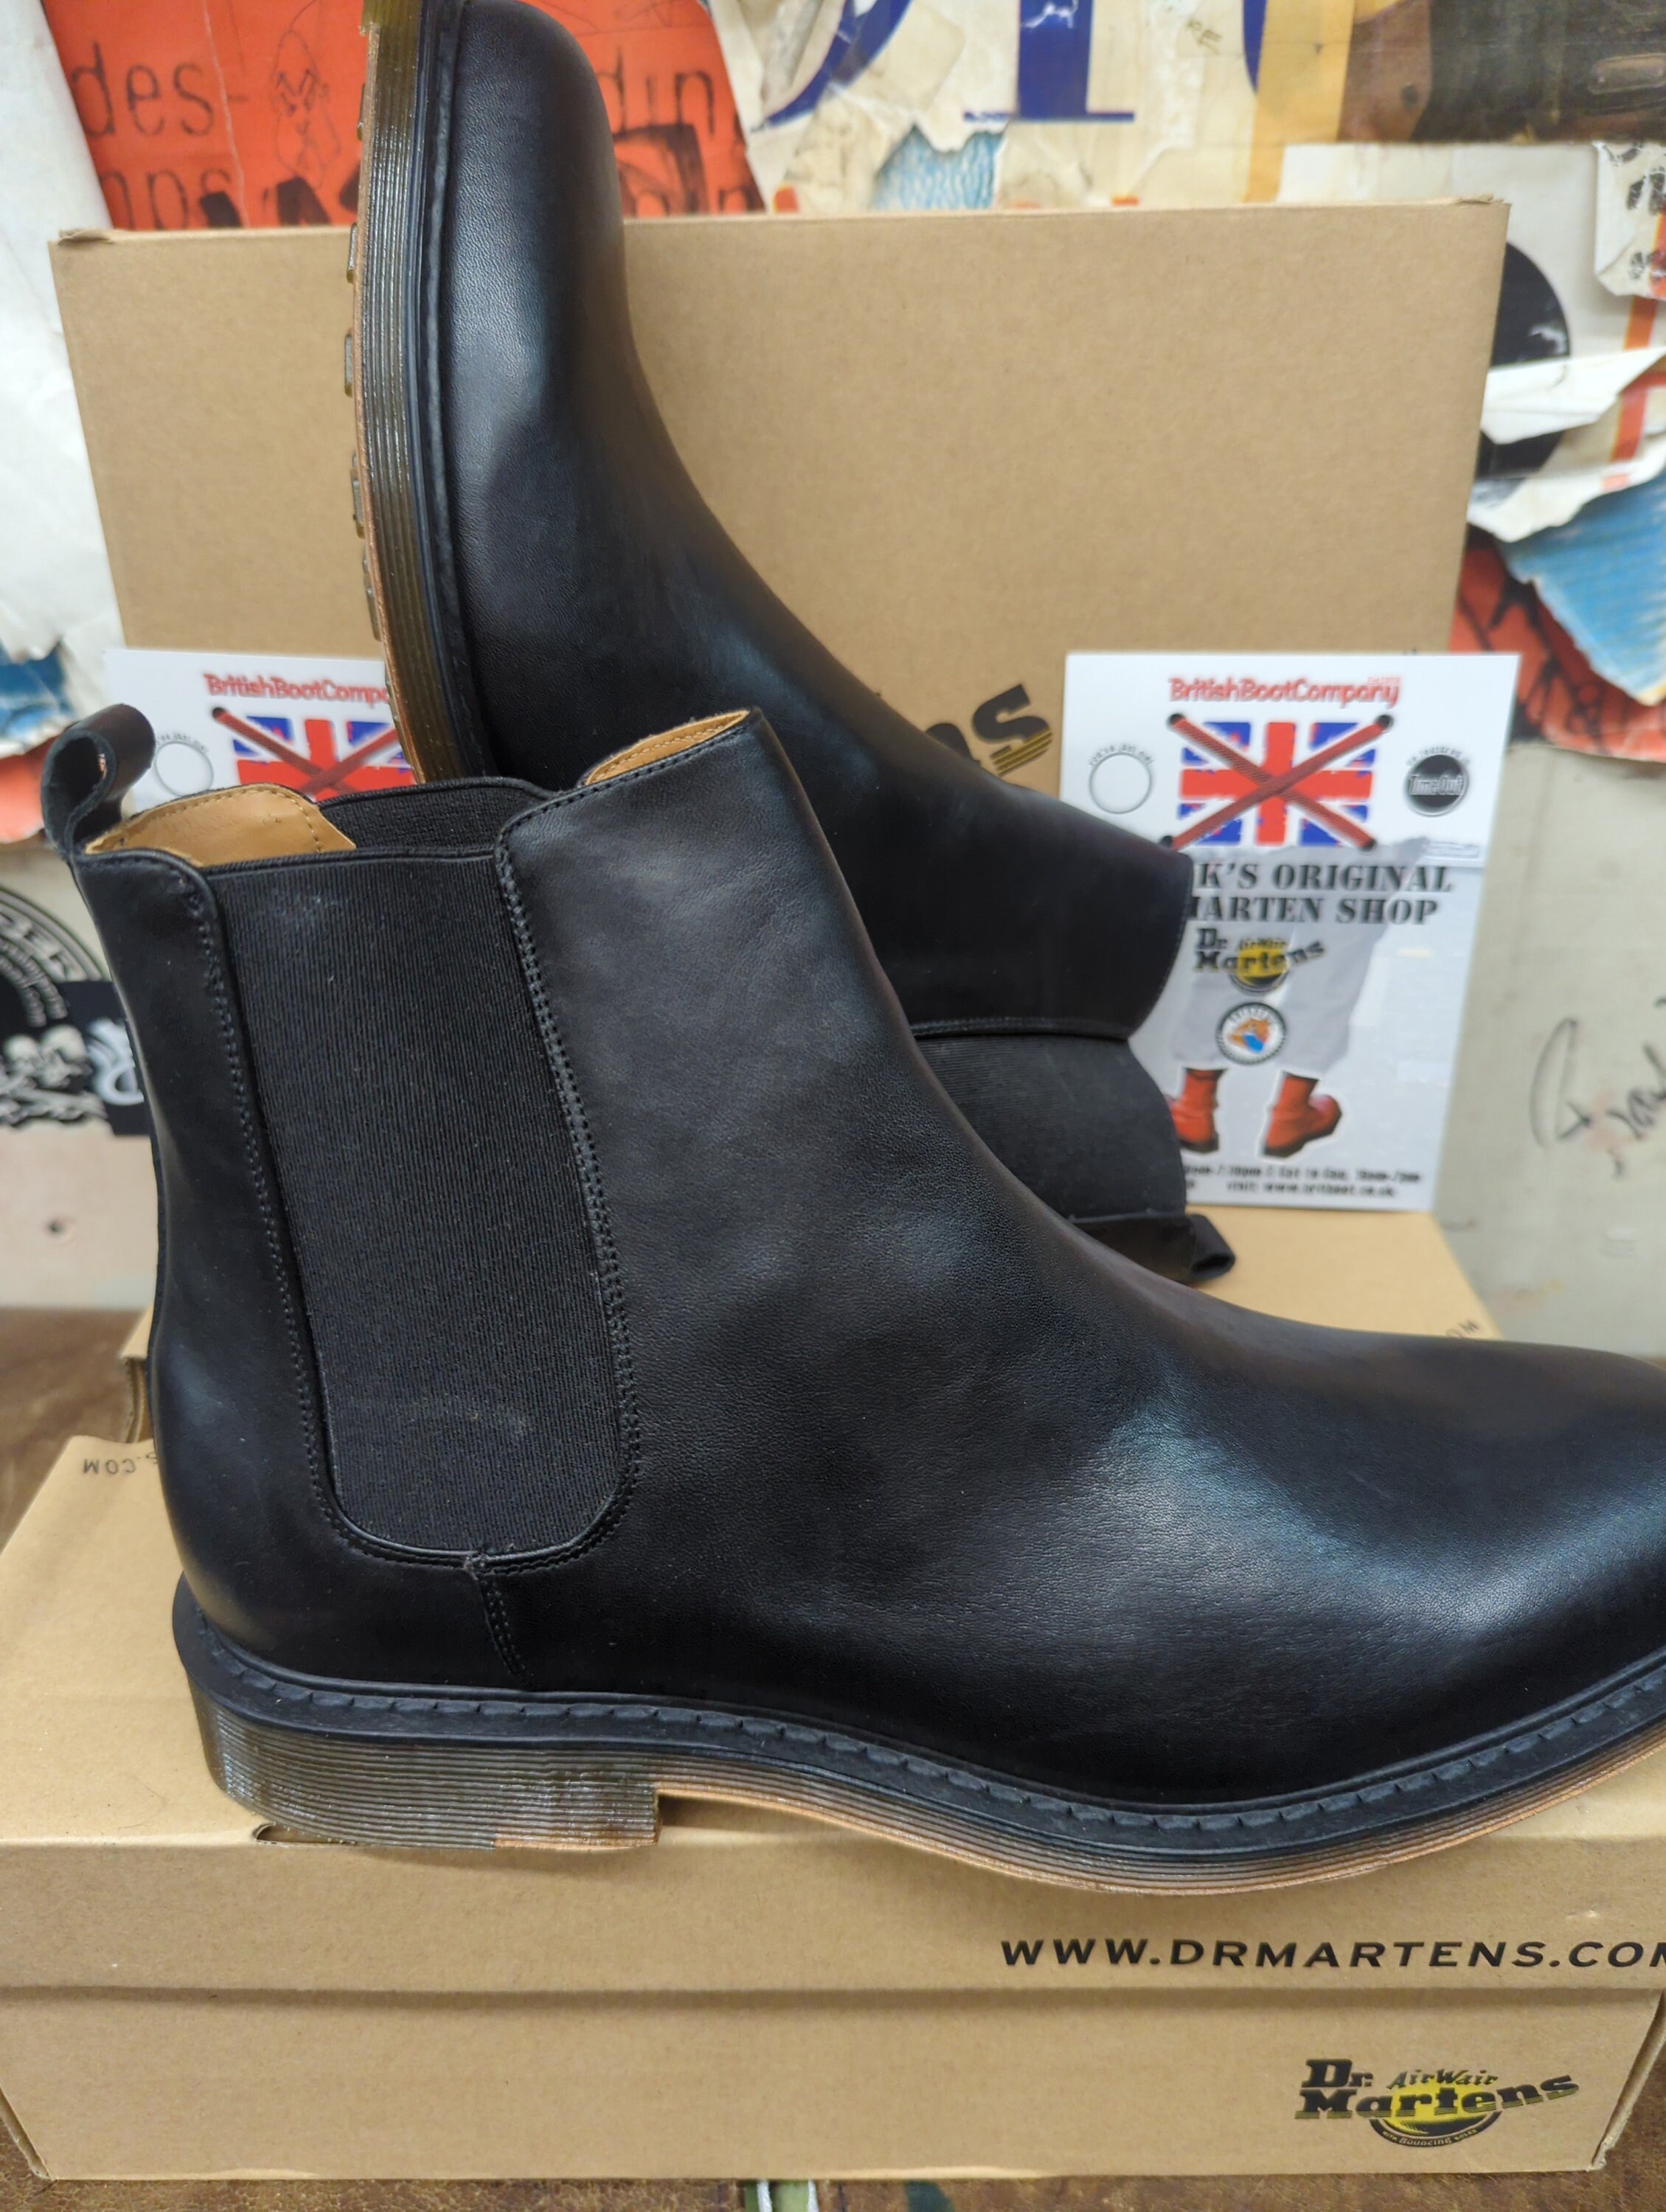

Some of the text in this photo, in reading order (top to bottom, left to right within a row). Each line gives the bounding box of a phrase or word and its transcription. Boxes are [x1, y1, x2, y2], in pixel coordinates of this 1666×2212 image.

[204, 672, 390, 709] BritishBootCompa
[1168, 675, 1401, 709] BritishBootCompany
[1198, 863, 1453, 893] K'S ORIGINAL
[1336, 897, 1440, 925] SHOP
[1302, 2058, 1374, 2088] Dr.
[1386, 2067, 1499, 2090] AirWair
[1294, 2074, 1580, 2120] Martens
